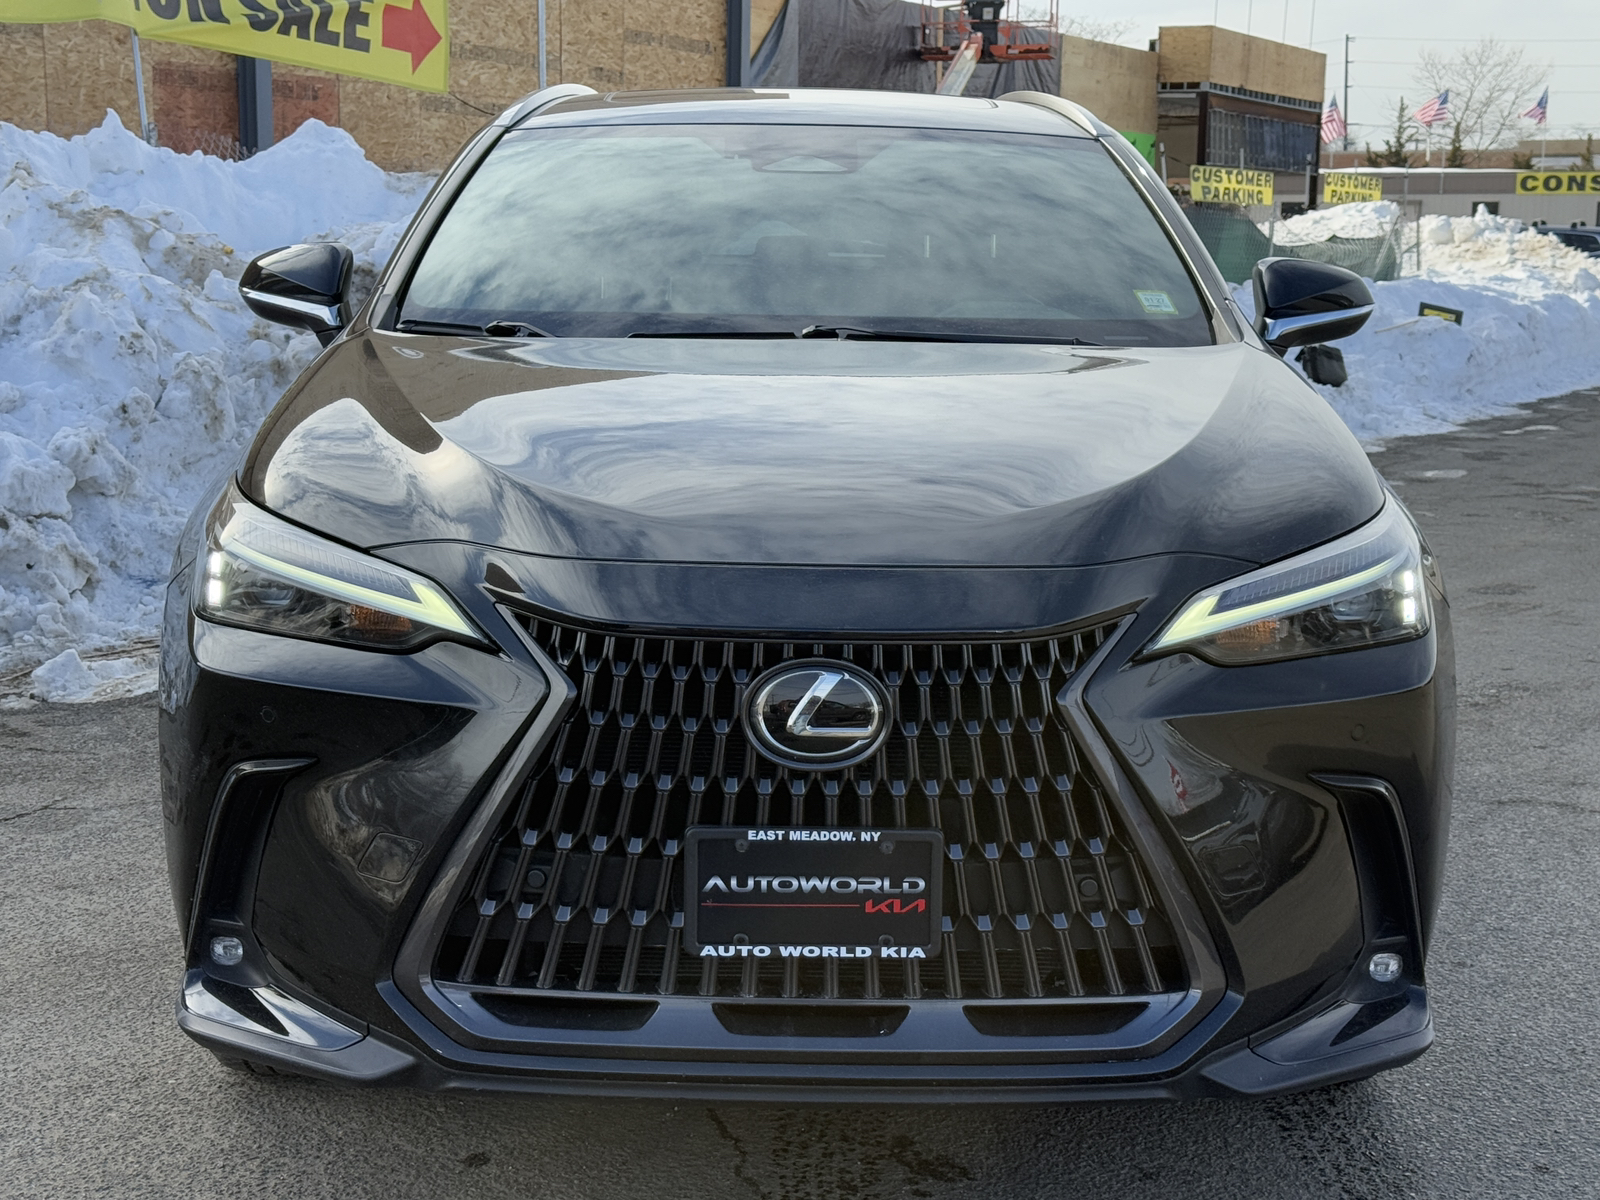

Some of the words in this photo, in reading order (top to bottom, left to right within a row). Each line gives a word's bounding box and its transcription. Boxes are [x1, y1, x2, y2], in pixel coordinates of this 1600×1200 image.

[239, 0, 371, 53] SALE
[1192, 167, 1272, 188] CUSTOMER
[1325, 174, 1380, 192] CUSTOMER
[1202, 186, 1264, 204] PARKING
[747, 830, 785, 841] EAST
[789, 830, 856, 842] MEADOW,
[861, 831, 881, 842] NY
[702, 875, 926, 894] AUTOWORLD
[866, 898, 926, 913] KIA
[700, 945, 772, 957] AUTO
[779, 946, 873, 958] WORLD
[881, 946, 927, 958] KIA
